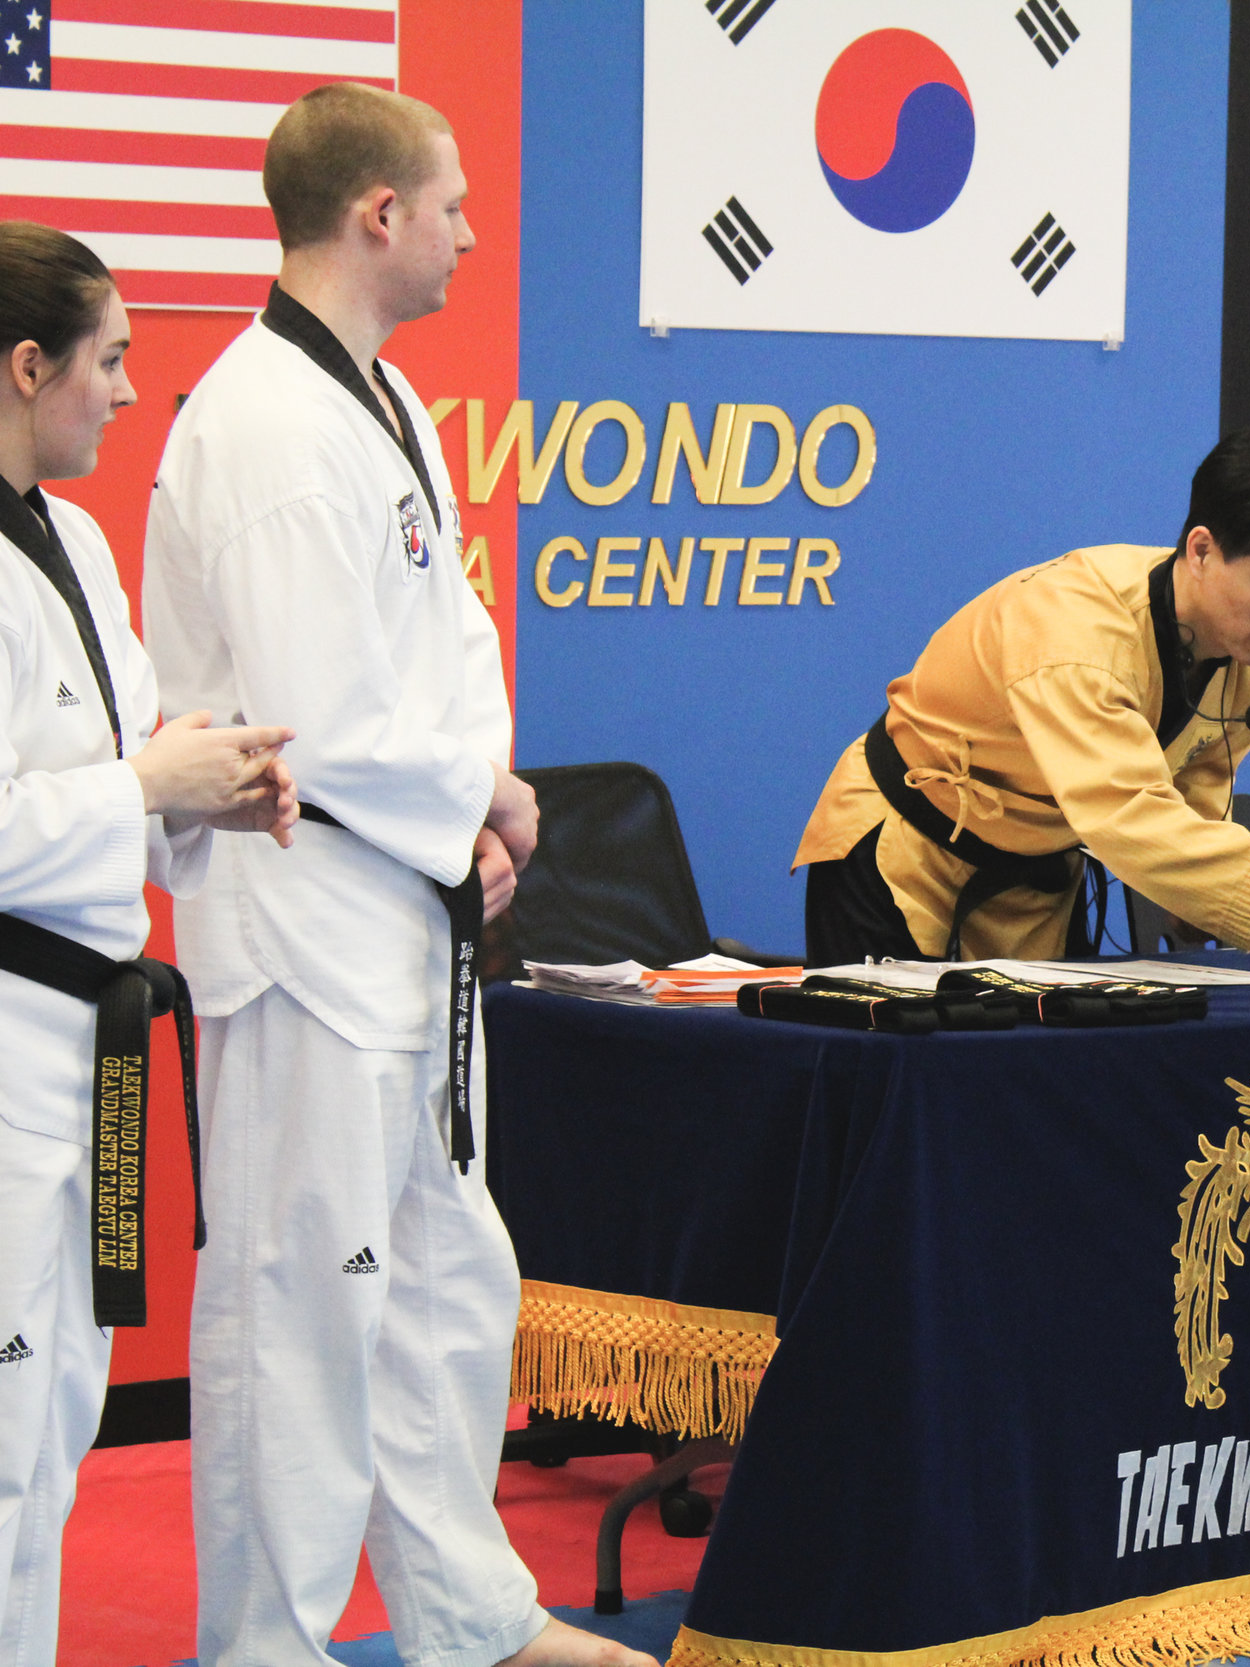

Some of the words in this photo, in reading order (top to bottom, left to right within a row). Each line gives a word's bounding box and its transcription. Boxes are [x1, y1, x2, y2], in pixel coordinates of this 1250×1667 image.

[534, 535, 841, 608] CENTER
[99, 1056, 121, 1172] GRANDMASTER
[120, 1055, 142, 1151] TAEKWONDO
[98, 1175, 117, 1237] TAEGYU
[119, 1155, 139, 1207] KOREA
[98, 1238, 117, 1268] LIM
[119, 1211, 138, 1271] CENTER
[343, 1263, 379, 1274] adidas
